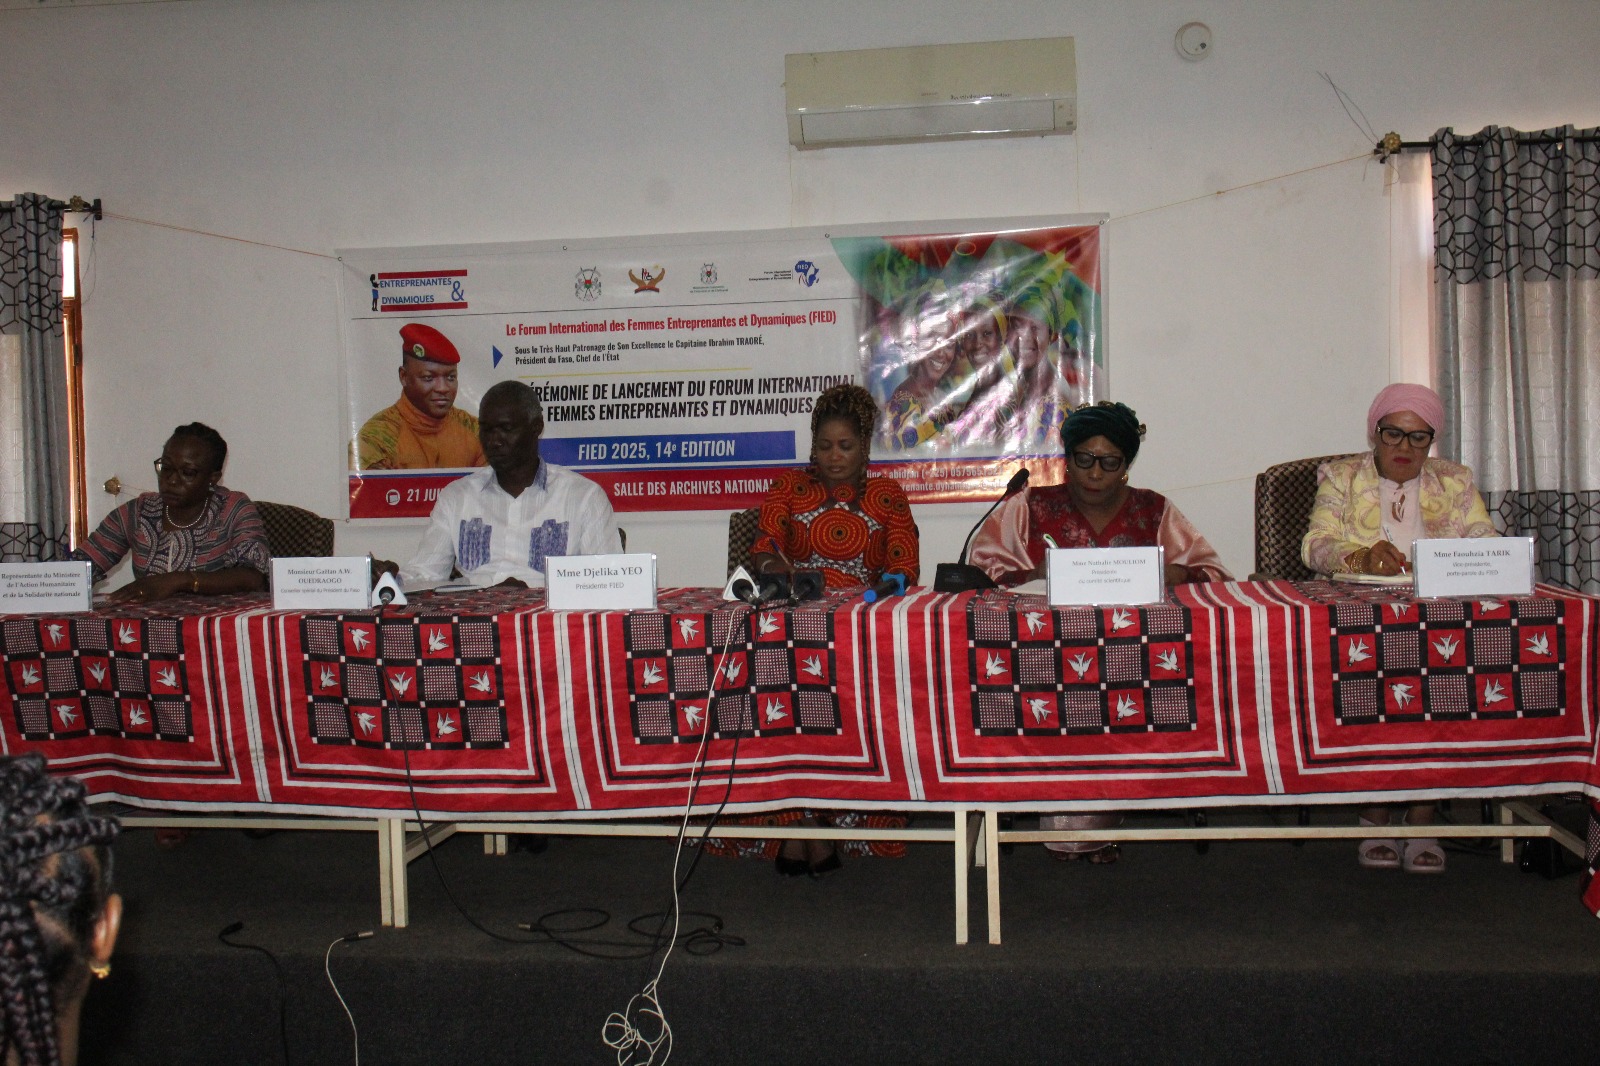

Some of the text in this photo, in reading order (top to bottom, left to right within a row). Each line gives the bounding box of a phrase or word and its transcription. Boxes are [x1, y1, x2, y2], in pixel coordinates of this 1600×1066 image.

[380, 278, 451, 288] ENTREPRENANTES
[451, 281, 464, 301] &
[382, 295, 434, 304] DYNAMIQUES
[506, 310, 836, 336] Le Forum International des Femmes Entreprenantes et Dynamiques (FIED)
[515, 346, 530, 355] Sous
[540, 345, 553, 353] Très
[555, 345, 570, 353] Haut
[572, 343, 605, 353] Patronage
[607, 343, 616, 351] de
[617, 342, 629, 350] Son
[631, 340, 665, 350] Excellence
[676, 339, 707, 349] Capitaine
[709, 338, 734, 347] Ibrahim
[736, 335, 765, 346] TRAORÉ,
[515, 351, 620, 365] Président du Faso, Chef de l'État
[530, 381, 588, 402] RÉMONIE
[593, 383, 608, 400] DE
[612, 381, 684, 399] LANCEMENT
[688, 380, 706, 397] DU
[709, 378, 754, 396] FORUM
[547, 397, 813, 422] FEMMES ENTREPRENANTES ET DYNAMIQUES
[578, 443, 607, 461] FIED
[611, 442, 650, 460] 2025,
[681, 440, 736, 458] EDITION
[406, 488, 420, 502] 21
[614, 479, 773, 496] SALLE DES ARCHIVES NATIONA
[1486, 549, 1511, 557] TARIK
[556, 566, 643, 578] Mme Djelika YEO
[575, 582, 608, 590] Présidente
